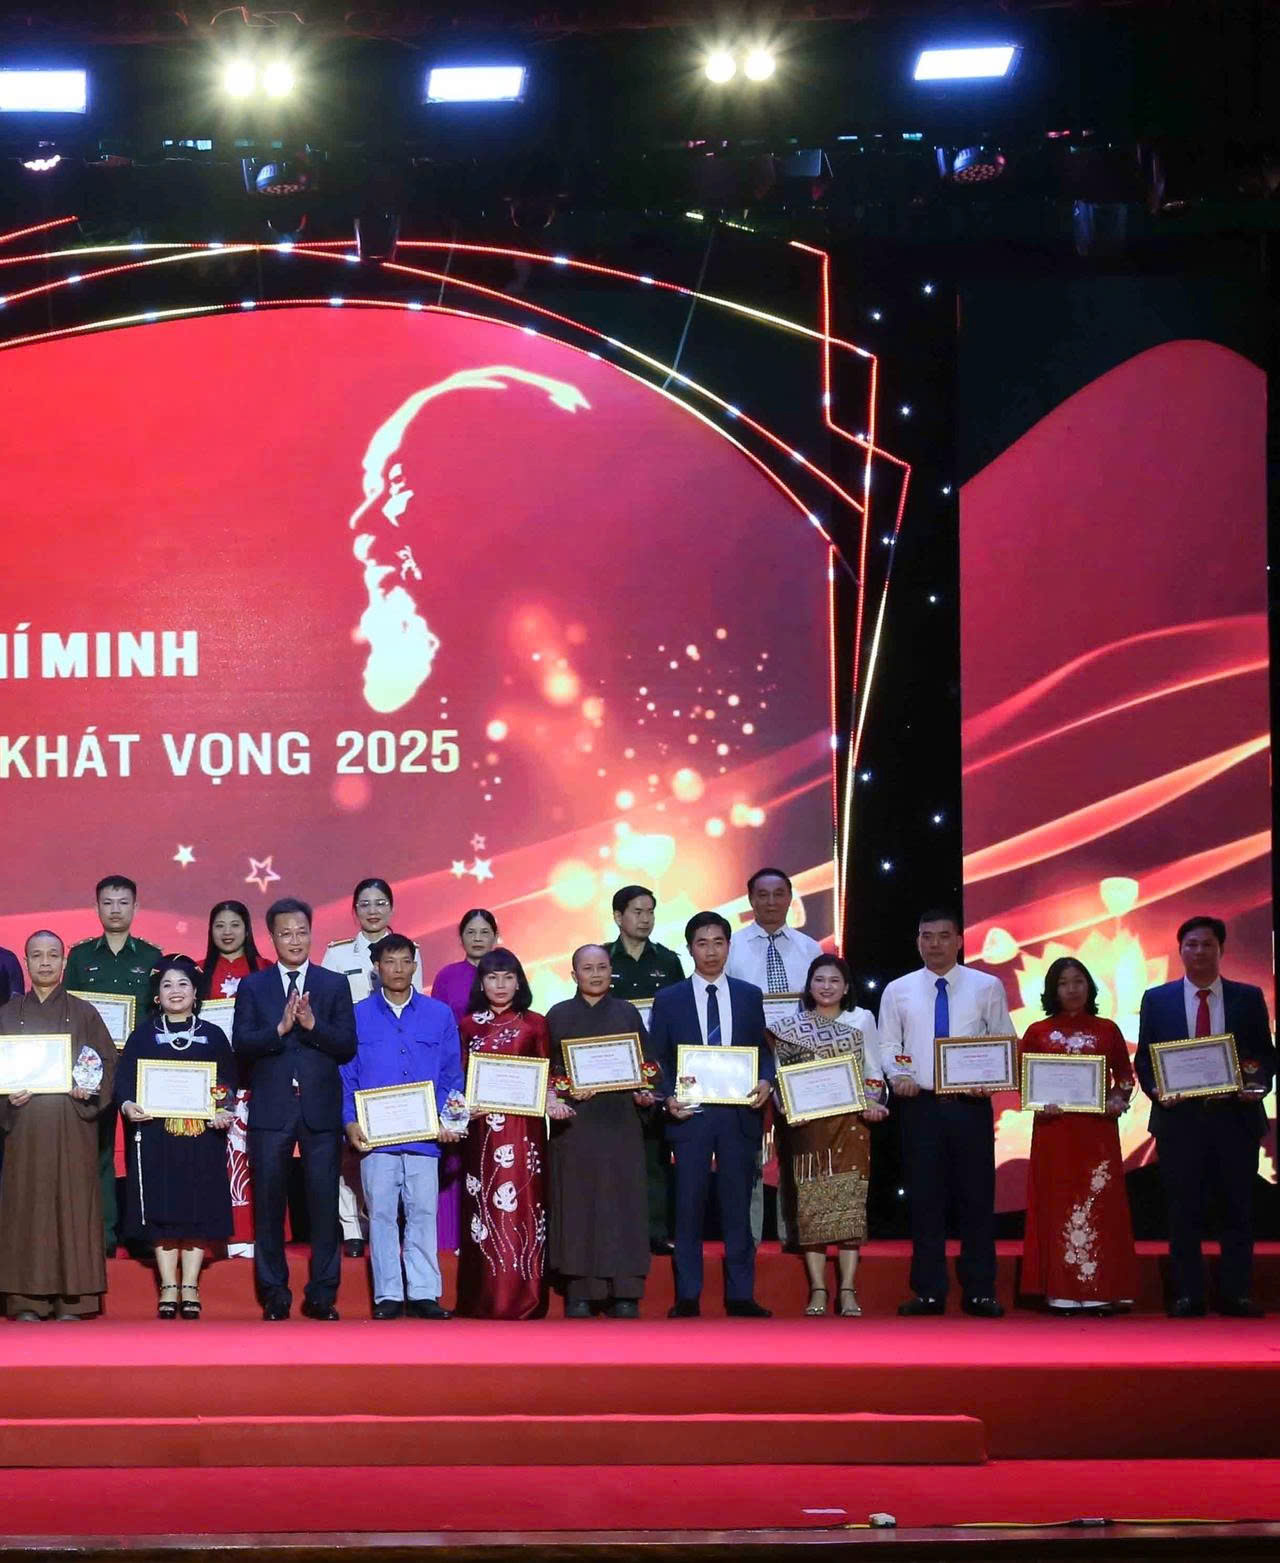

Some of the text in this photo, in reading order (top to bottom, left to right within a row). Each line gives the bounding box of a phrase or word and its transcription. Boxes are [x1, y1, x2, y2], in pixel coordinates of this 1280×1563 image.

[41, 630, 198, 679] MINH
[162, 731, 311, 785] VỌNG
[336, 729, 460, 774] 2025
